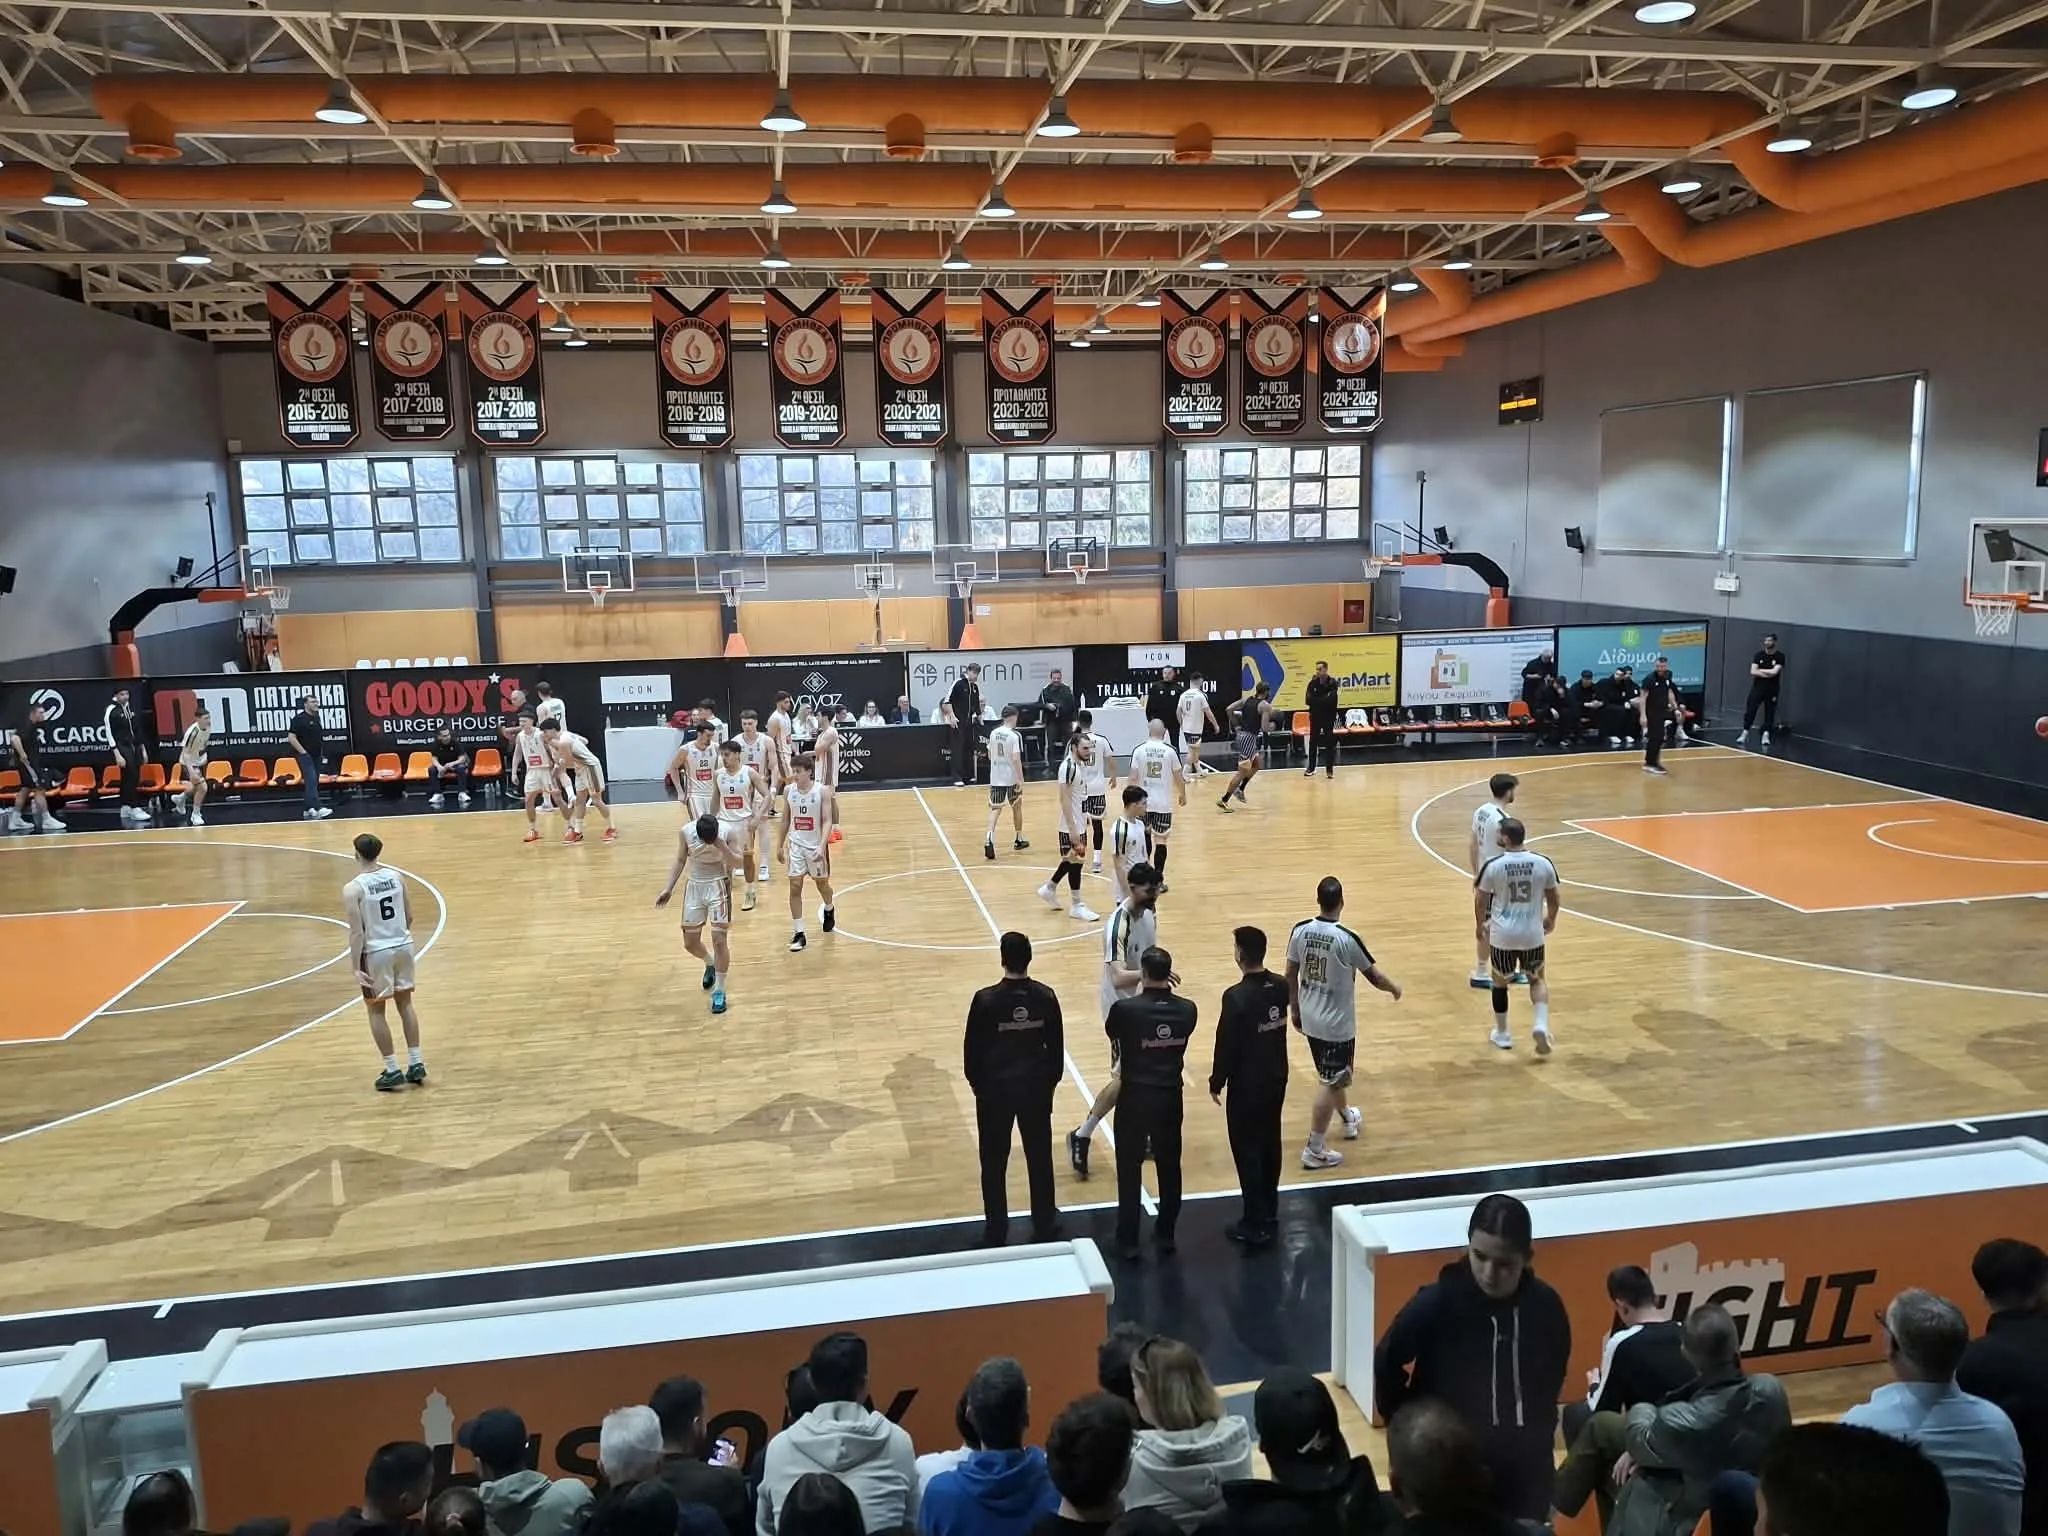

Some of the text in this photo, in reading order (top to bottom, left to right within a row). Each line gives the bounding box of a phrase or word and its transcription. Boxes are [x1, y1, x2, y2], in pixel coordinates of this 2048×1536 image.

[407, 382, 430, 396] ΘΕΣΗ
[1192, 383, 1211, 395] ΘΕΣΗ
[1270, 381, 1288, 394] ΘΕΣΗ
[1347, 378, 1366, 390] ΘΕΣΗ
[312, 388, 335, 402] ΘΕΣΗ
[500, 387, 523, 400] ΘΕΣΗ
[803, 390, 824, 404] ΘΕΣΗ
[907, 390, 928, 403] ΘΕΣΗ
[1323, 391, 1378, 406] 2024-2025
[384, 397, 444, 413] 2017-2018
[477, 401, 536, 418] 2017-2018
[1169, 396, 1222, 411] 2021-2022
[1245, 394, 1301, 410] 2024-2025
[288, 403, 349, 420] 2015-2016
[668, 405, 725, 421] 2018-2019
[780, 404, 838, 421] 2019-2020
[884, 403, 940, 420] 2020-2021
[993, 402, 1048, 418] 2020-2021
[1145, 652, 1170, 661] ICON
[366, 673, 520, 716] GOODY'S
[622, 685, 653, 695] ICON
[1097, 683, 1133, 697] TRAIN
[790, 693, 842, 712] yayaz
[451, 716, 505, 731] HOUSE
[1508, 881, 1532, 903] 13
[379, 896, 395, 921] 6
[1306, 953, 1328, 984] 21
